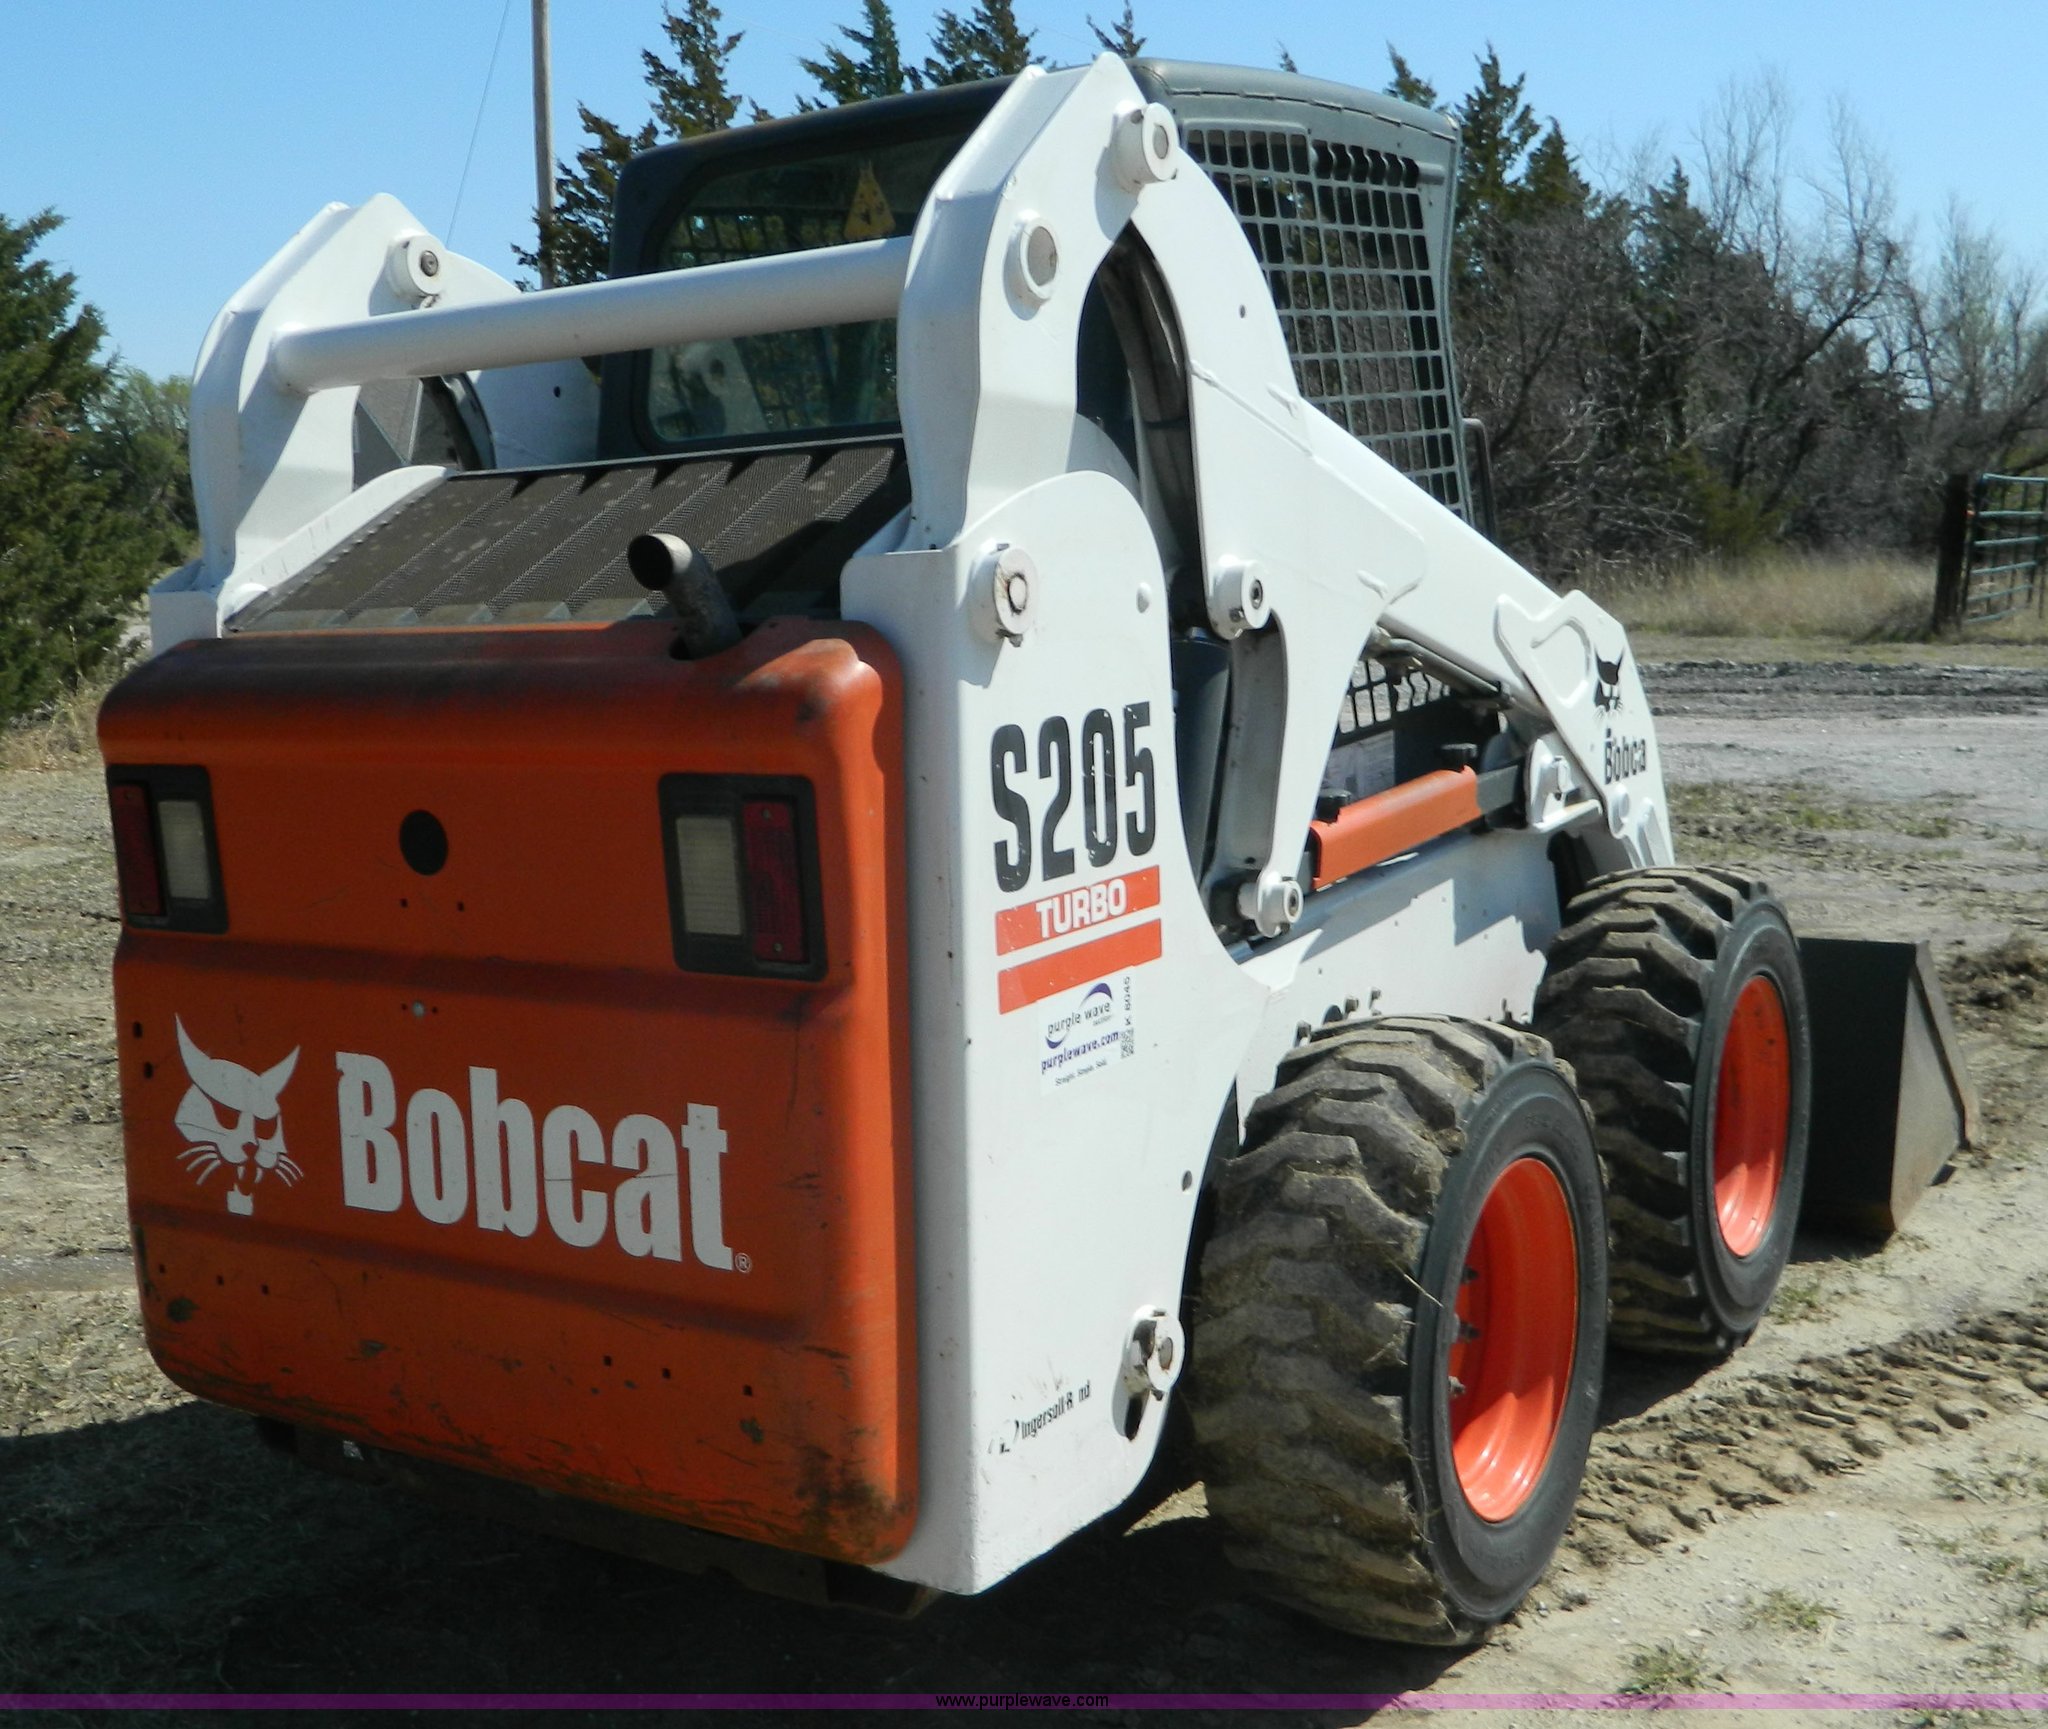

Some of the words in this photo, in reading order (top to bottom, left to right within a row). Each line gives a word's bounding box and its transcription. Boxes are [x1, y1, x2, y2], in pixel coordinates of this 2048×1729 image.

[991, 701, 1155, 893] S205
[1036, 878, 1127, 939] TURBO
[1047, 1012, 1081, 1038] purple
[1084, 1002, 1111, 1020] wave
[1041, 1031, 1119, 1075] purplewave.com
[335, 1051, 733, 1271] Bobcat
